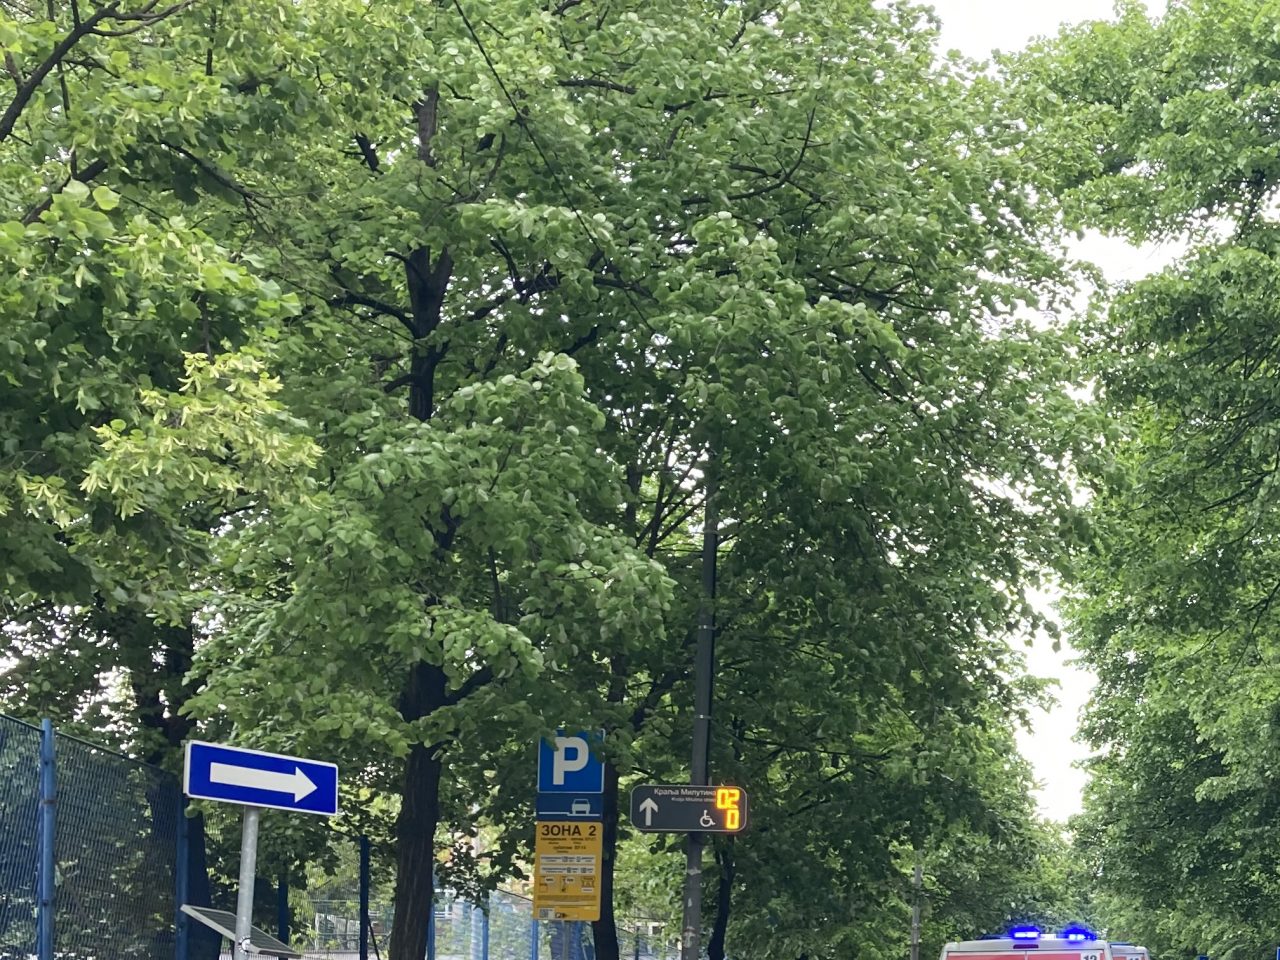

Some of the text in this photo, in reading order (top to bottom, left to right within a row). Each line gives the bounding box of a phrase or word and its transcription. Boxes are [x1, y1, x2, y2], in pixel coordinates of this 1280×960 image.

[553, 737, 589, 785] P
[716, 789, 740, 809] 02
[541, 825, 597, 836] ЗОНА 2
